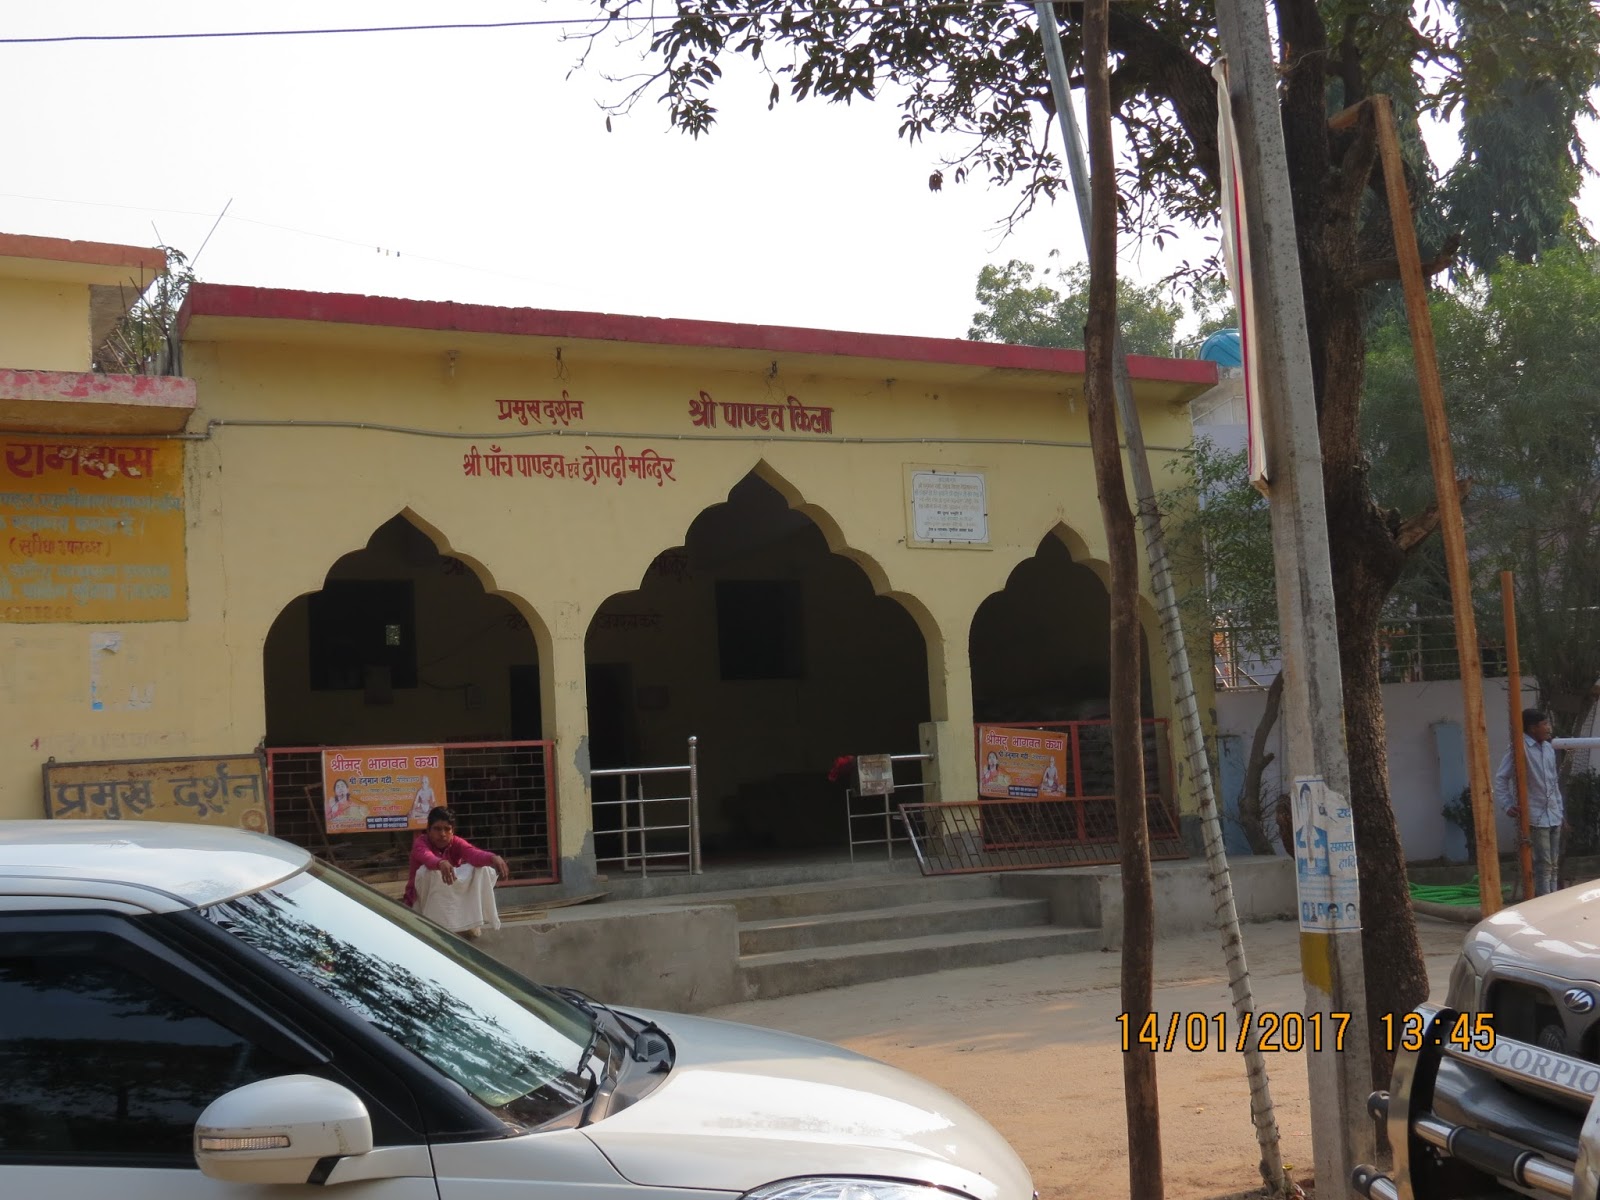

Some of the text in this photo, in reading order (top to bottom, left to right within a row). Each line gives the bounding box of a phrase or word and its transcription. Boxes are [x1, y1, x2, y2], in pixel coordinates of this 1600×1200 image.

[542, 390, 584, 426] दर्शन
[688, 390, 834, 434] श्री पाण्डव किला
[463, 445, 482, 477] श्री
[483, 444, 513, 477] पाँच
[513, 454, 565, 479] पाण्डव
[565, 457, 580, 479] एवं
[628, 448, 676, 487] मन्दिर
[1012, 736, 1041, 748] भागवत
[1045, 738, 1063, 750] कथा
[331, 754, 439, 776] श्रीमद् भागवत कथा
[168, 762, 259, 817] दर्शन
